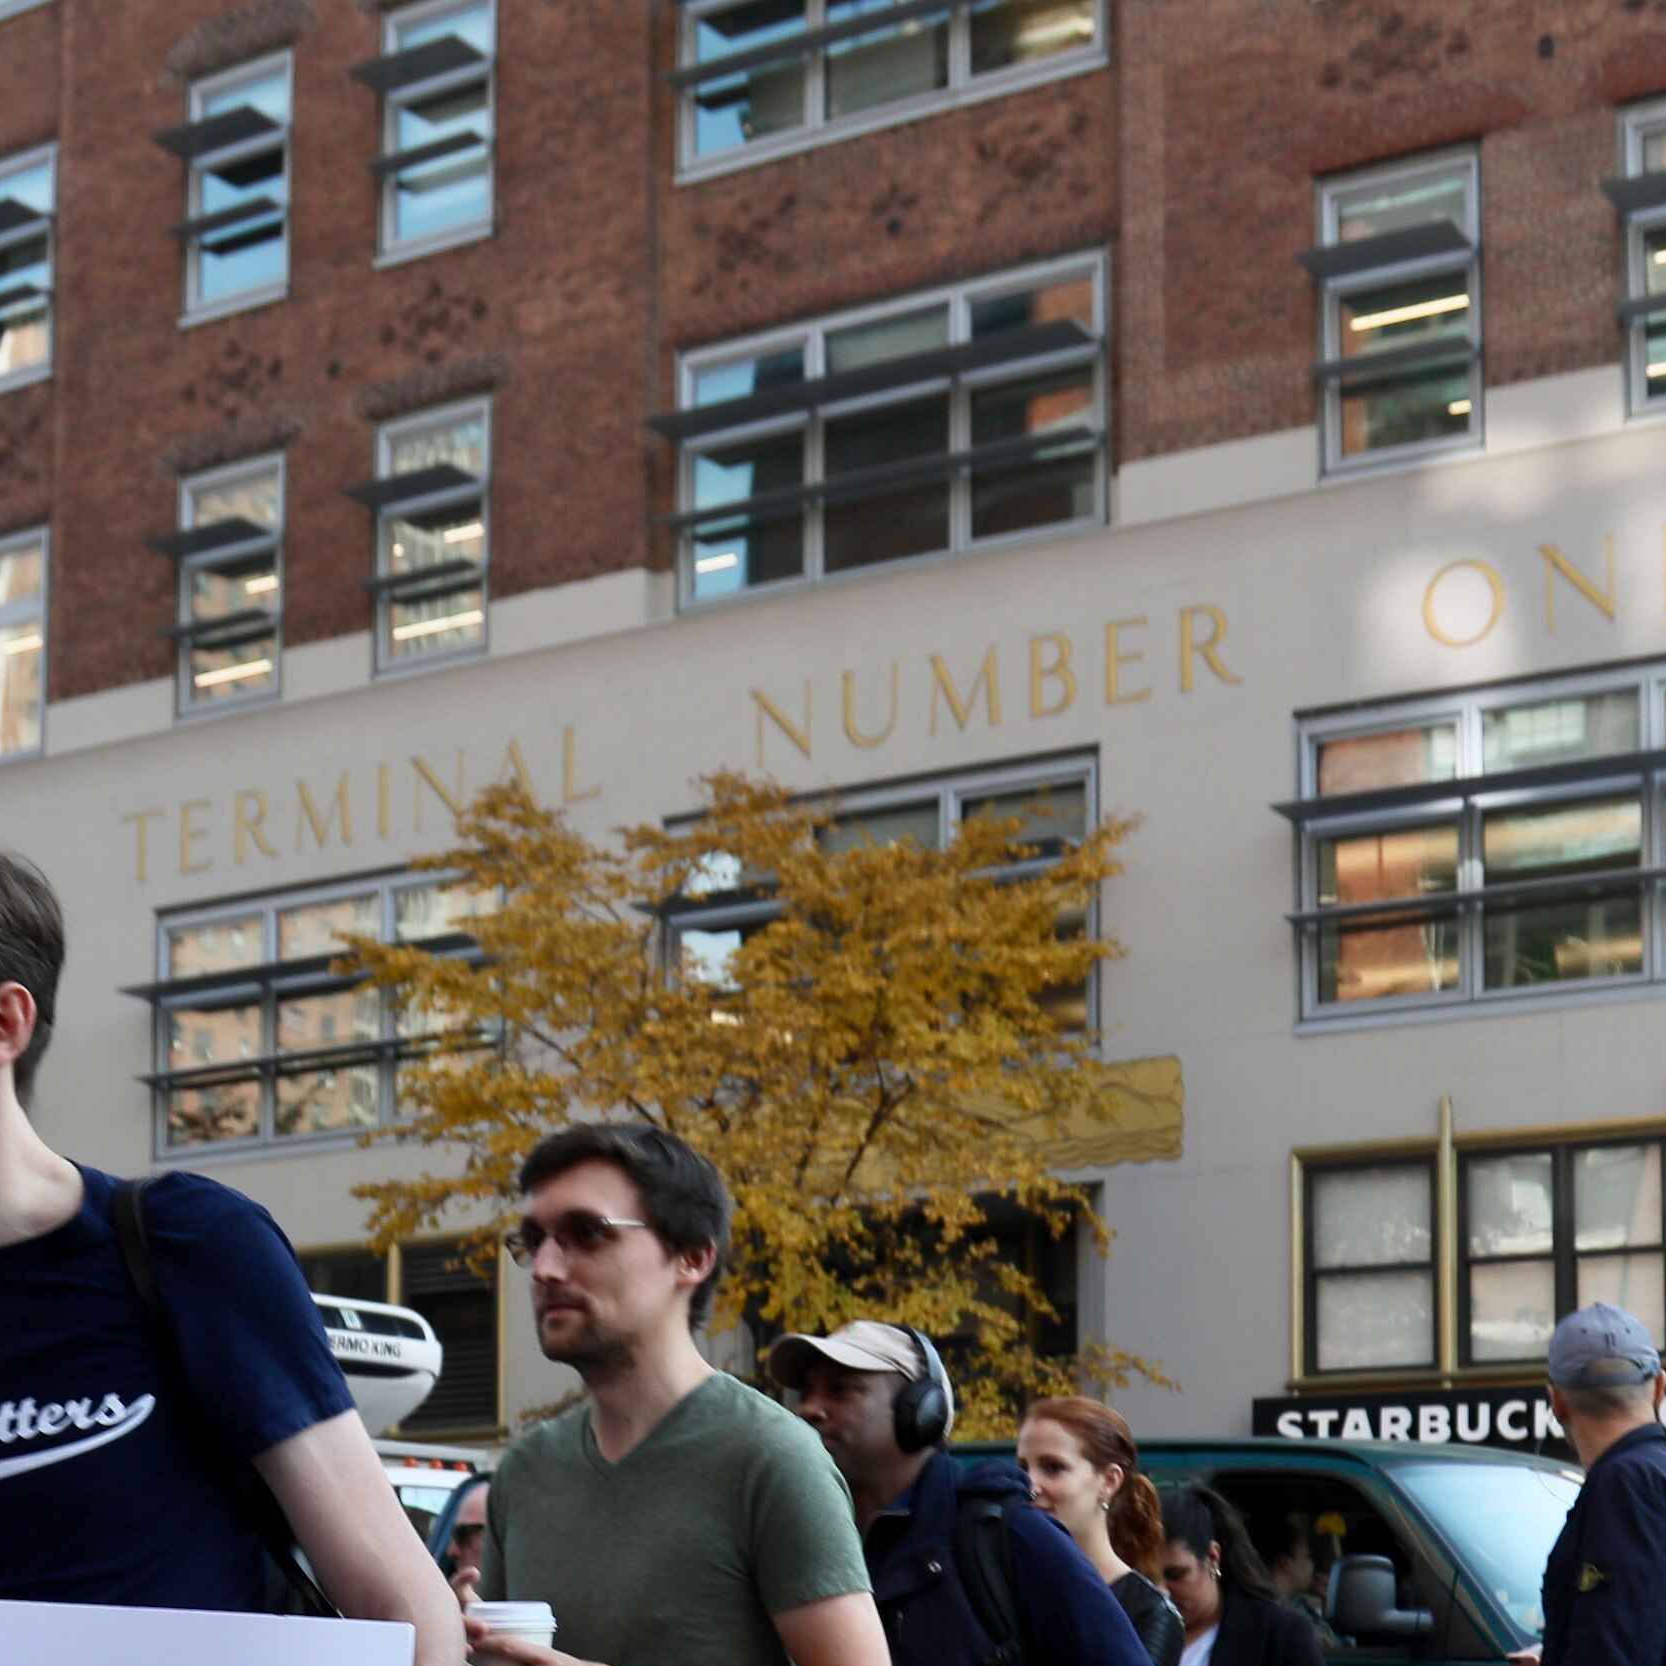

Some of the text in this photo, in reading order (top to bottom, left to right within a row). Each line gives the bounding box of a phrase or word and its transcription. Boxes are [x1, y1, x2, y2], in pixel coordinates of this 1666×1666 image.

[121, 725, 601, 882] TERMINAL
[749, 604, 1244, 765] NUMBER
[329, 1335, 402, 1358] ERMO KING
[1276, 1399, 1564, 1444] STARBUCK
